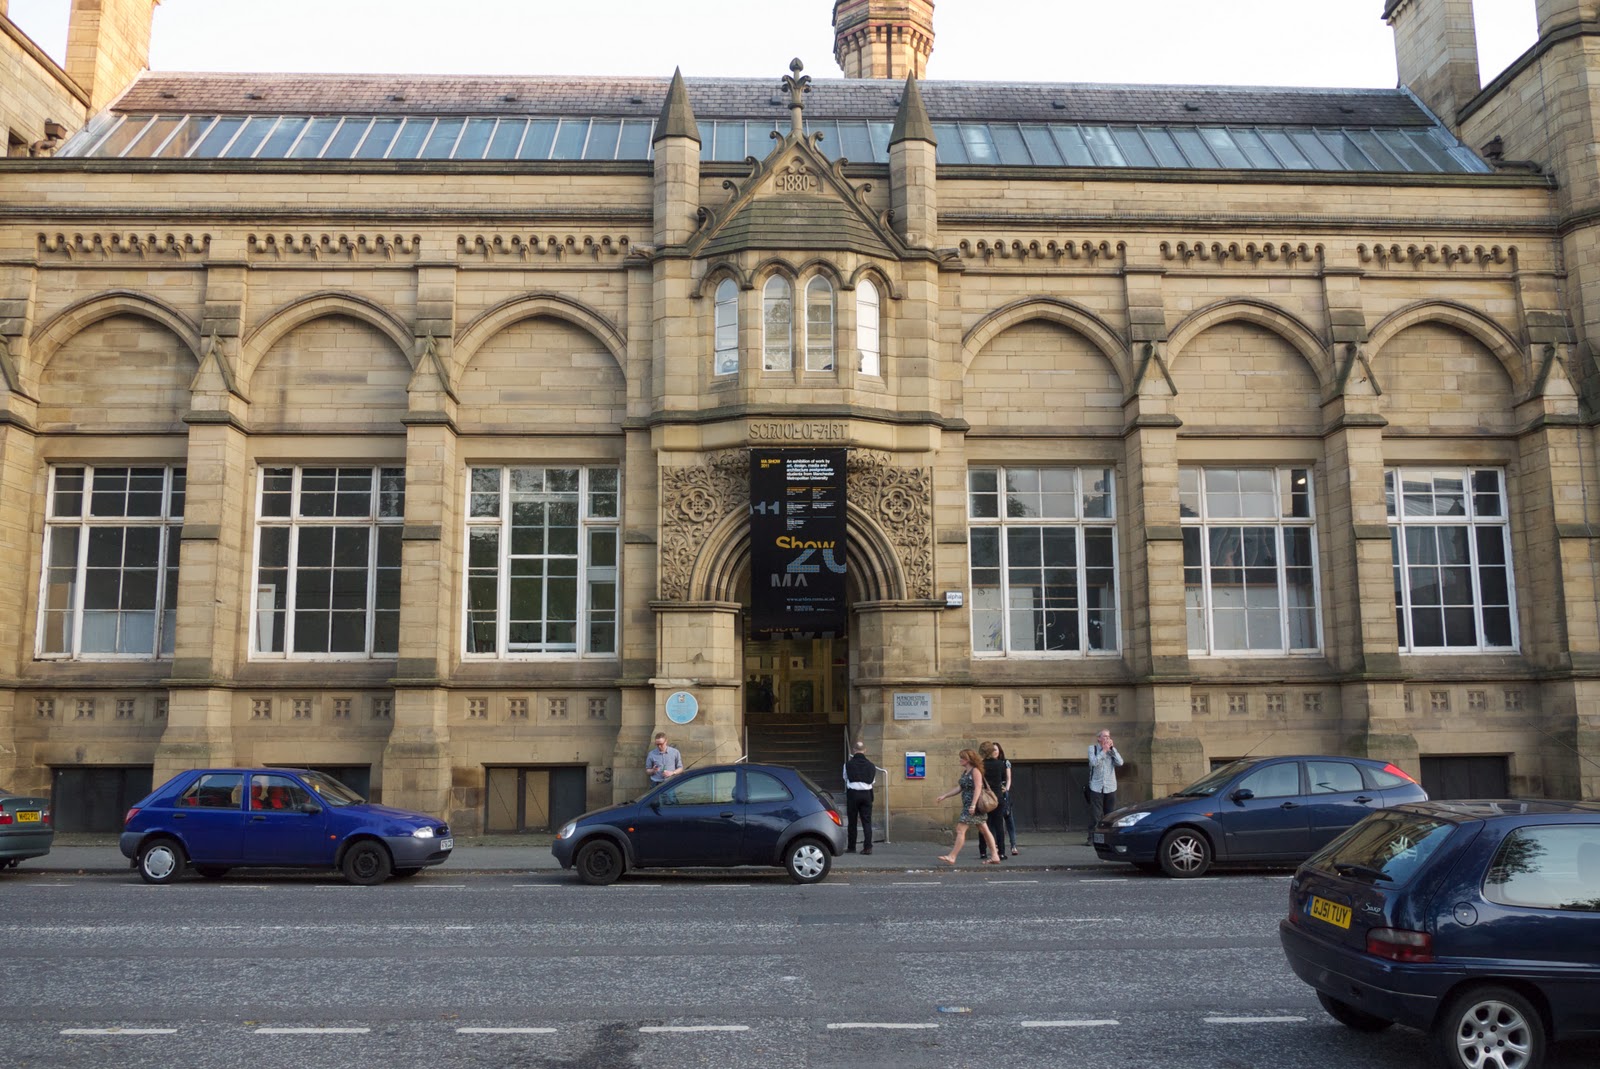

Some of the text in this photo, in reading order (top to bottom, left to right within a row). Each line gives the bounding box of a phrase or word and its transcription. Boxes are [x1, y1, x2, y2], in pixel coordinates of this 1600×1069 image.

[783, 174, 809, 191] 1880
[818, 422, 849, 441] ART
[775, 535, 835, 549] Show
[1313, 898, 1349, 924] GJ51 TUY
[1361, 902, 1381, 913] Saxo
